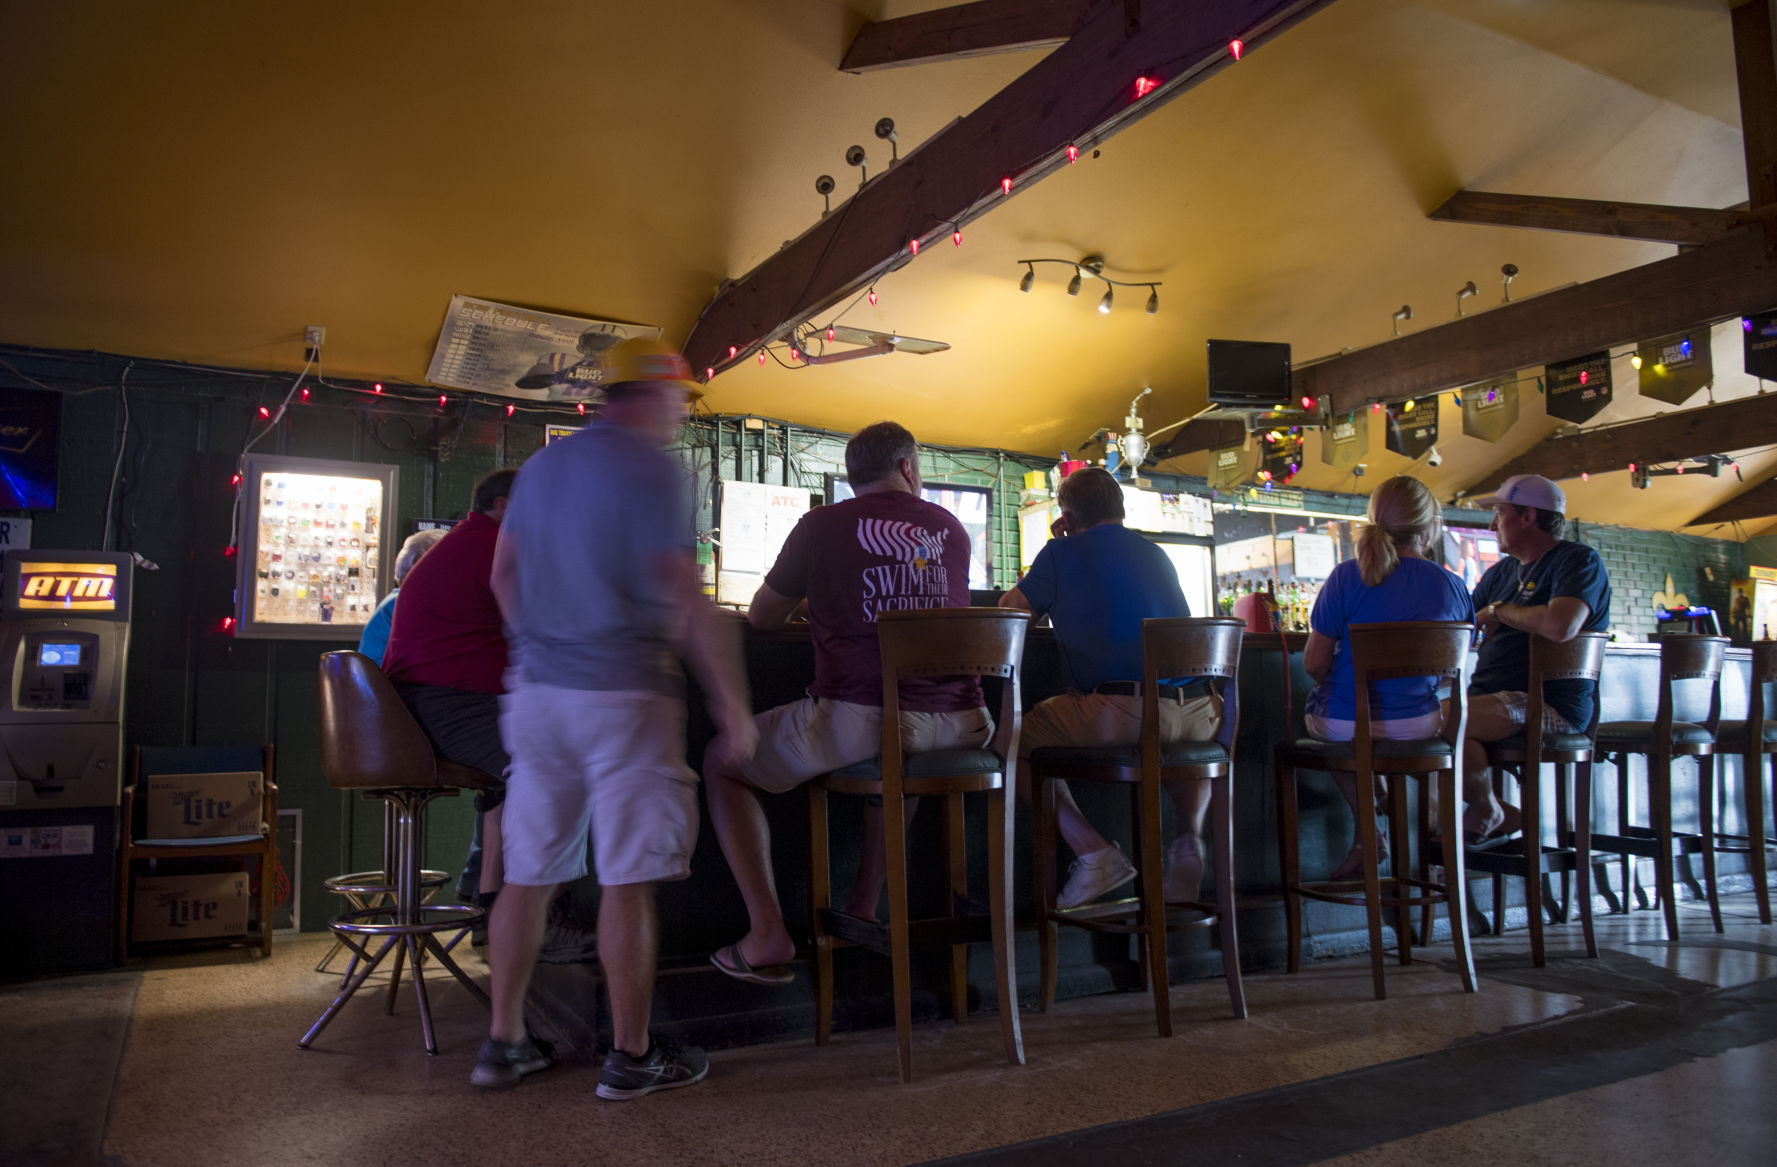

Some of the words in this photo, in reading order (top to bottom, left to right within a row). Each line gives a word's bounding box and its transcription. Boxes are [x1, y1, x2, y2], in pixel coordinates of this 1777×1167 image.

[460, 308, 549, 332] SCHEDULE
[1664, 344, 1689, 356] BU
[568, 371, 605, 381] LIGHT
[576, 367, 602, 376] BUD
[24, 576, 114, 597] ATM
[862, 560, 924, 599] SWIM
[926, 564, 947, 584] FOR
[183, 798, 232, 826] Lite
[168, 899, 219, 928] Lite
